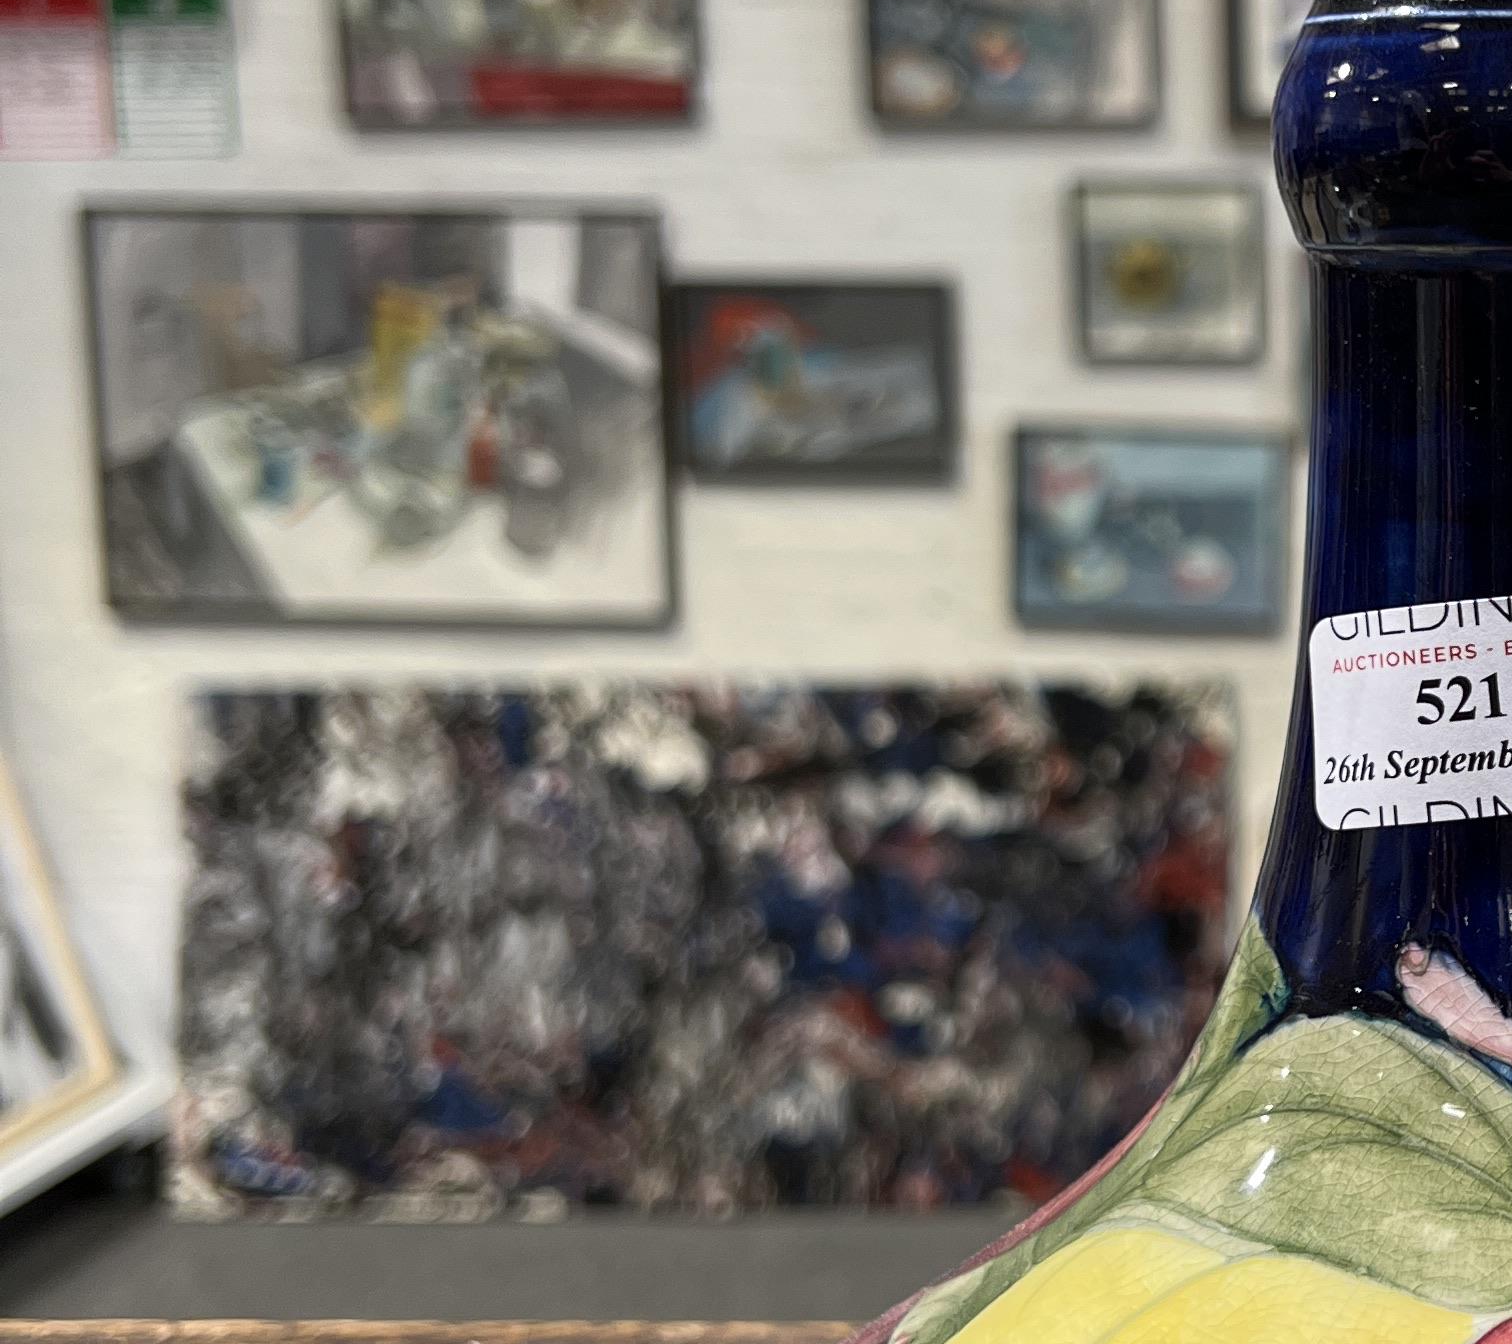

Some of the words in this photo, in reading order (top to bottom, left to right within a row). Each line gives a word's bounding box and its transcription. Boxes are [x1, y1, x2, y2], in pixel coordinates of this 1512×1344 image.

[1332, 643, 1478, 674] AUCTIONEERS
[1416, 672, 1507, 725] 521
[1323, 753, 1376, 785] 26th
